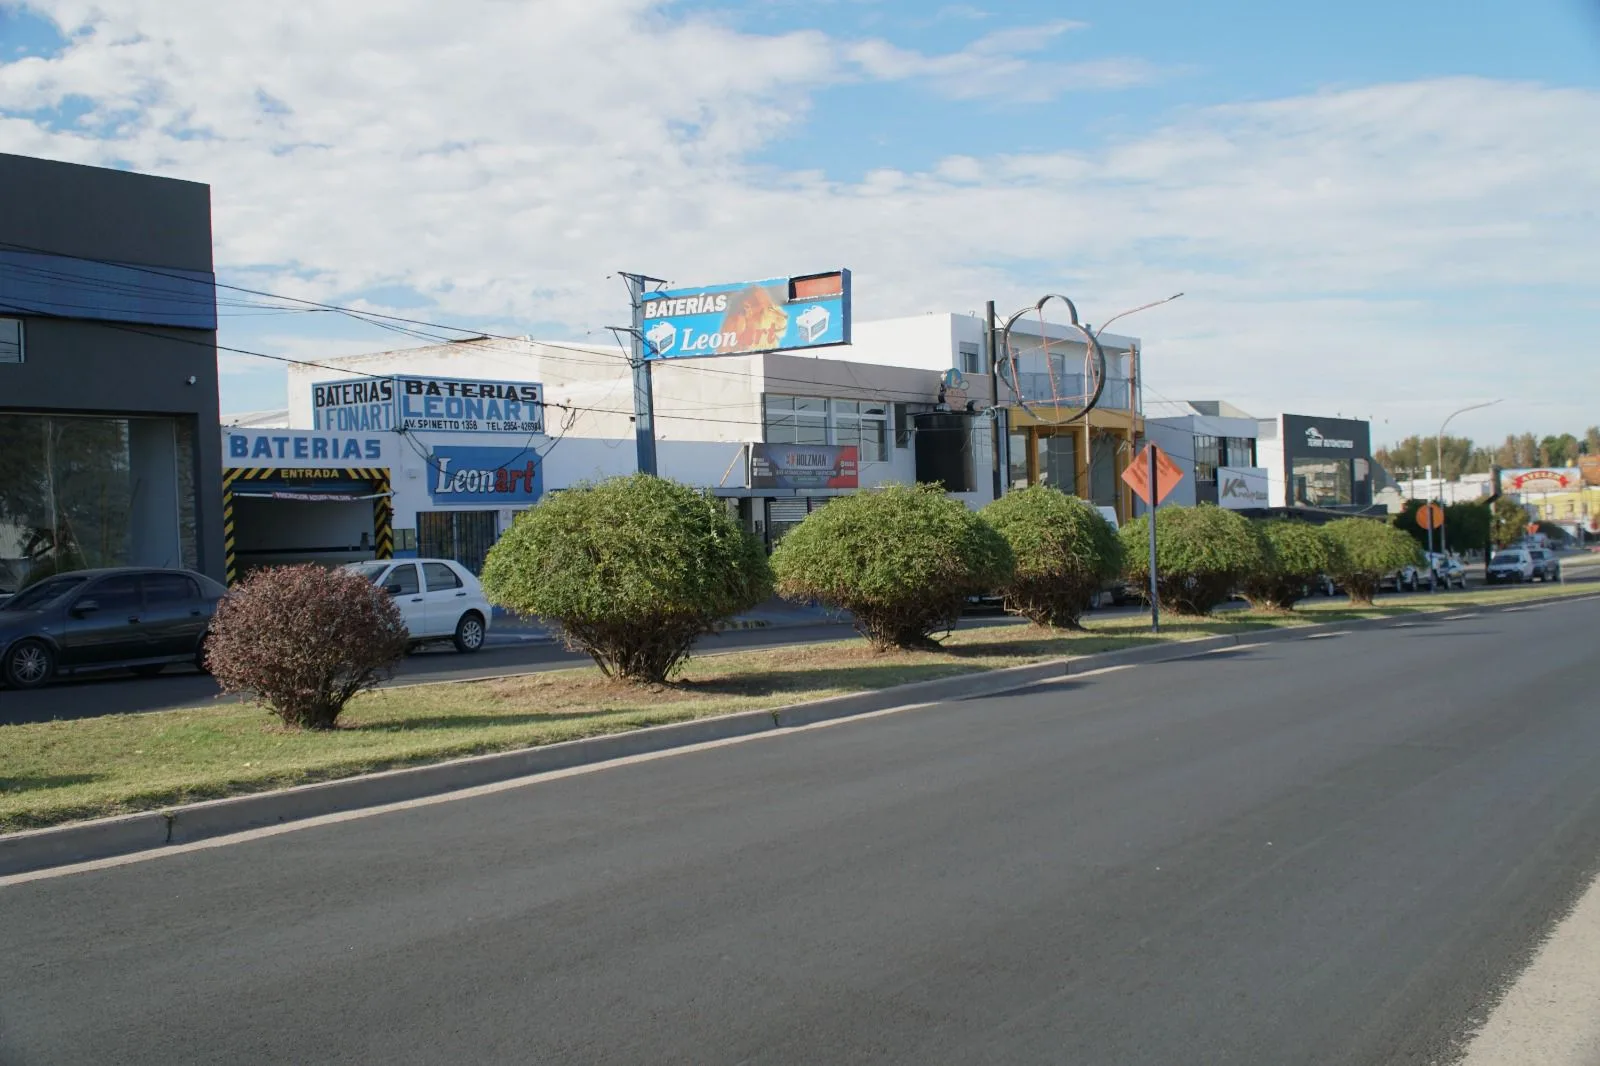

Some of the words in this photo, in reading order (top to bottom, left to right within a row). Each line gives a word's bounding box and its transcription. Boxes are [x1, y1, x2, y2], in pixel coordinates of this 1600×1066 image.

[645, 293, 728, 319] BATERÍAS
[315, 380, 392, 408] BATERIAS
[405, 380, 537, 400] BATERIAS
[402, 395, 536, 421] LEONART
[403, 419, 416, 429] AV.
[418, 420, 460, 430] SPINETTO
[230, 435, 381, 460] BATERIAS
[796, 453, 827, 467] HOLZMAN
[280, 468, 340, 479] ENTRADA
[435, 457, 536, 494] Leonart
